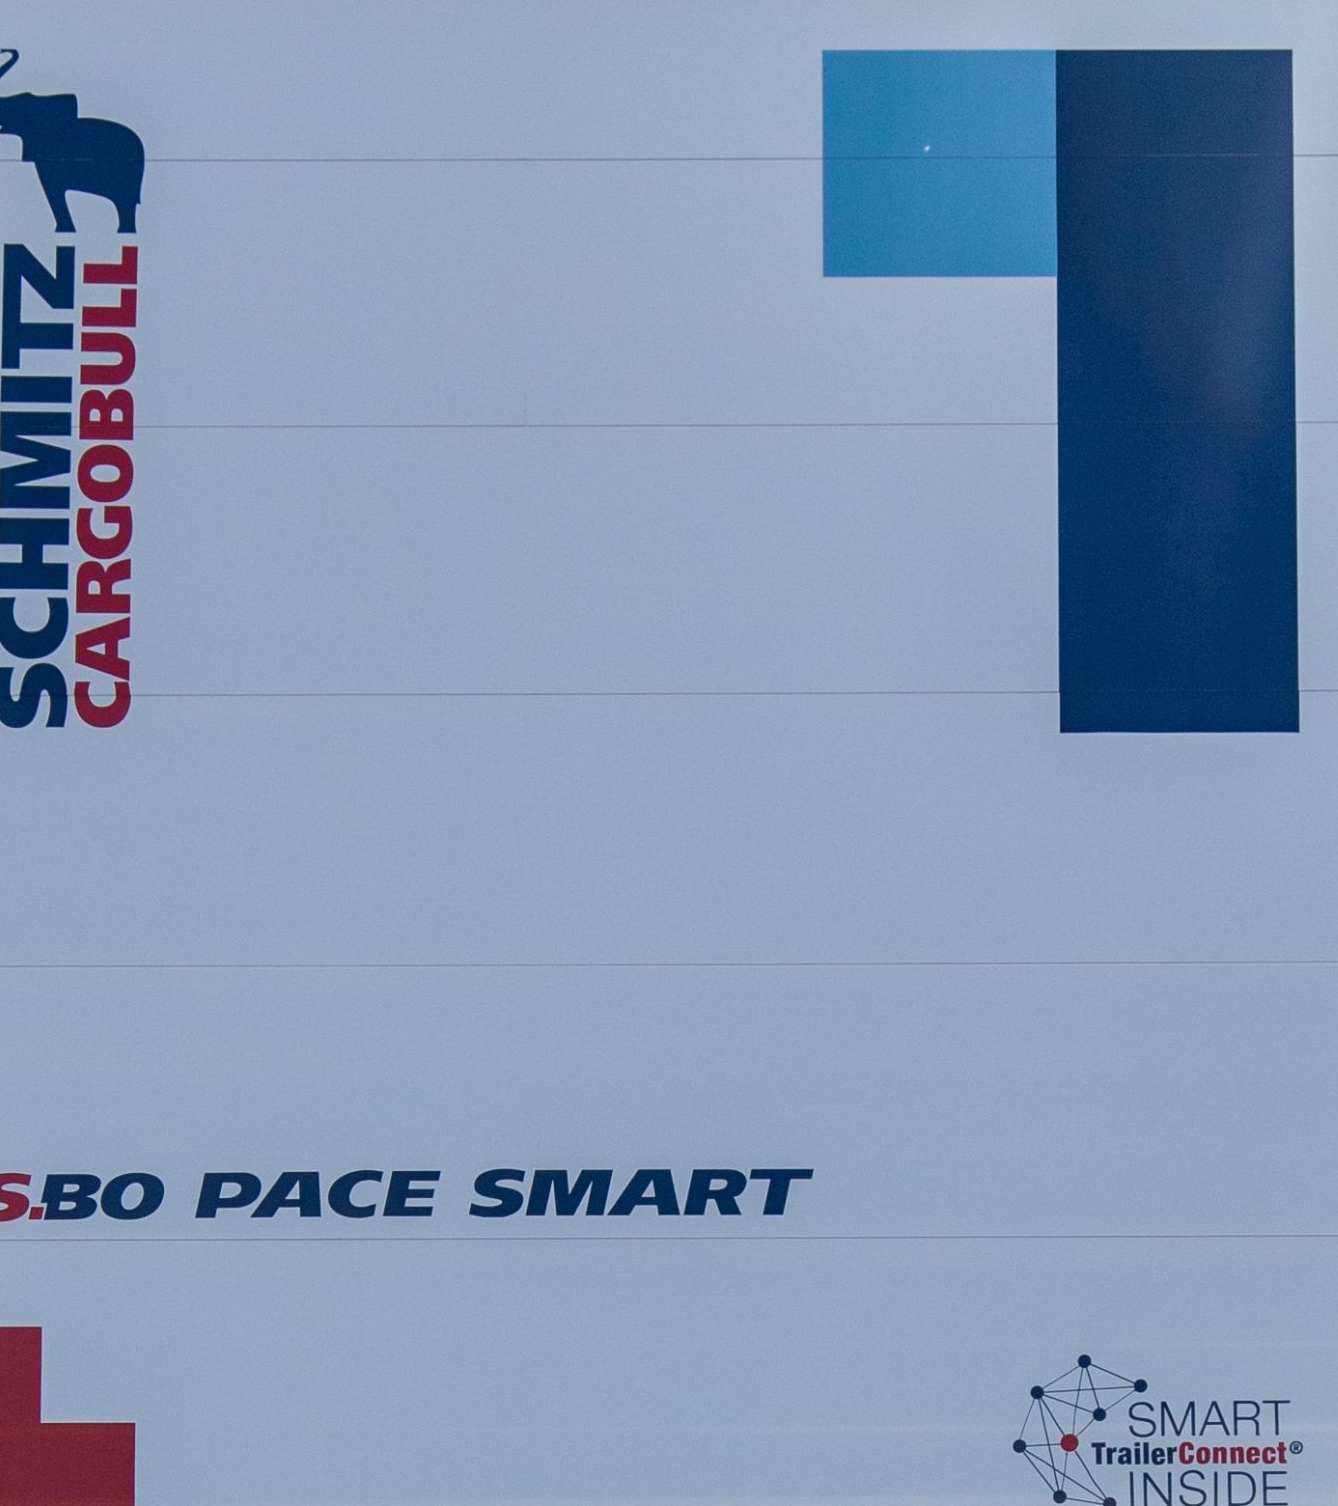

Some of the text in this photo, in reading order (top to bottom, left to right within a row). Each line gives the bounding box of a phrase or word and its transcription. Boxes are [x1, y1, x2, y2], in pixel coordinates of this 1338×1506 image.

[73, 245, 139, 728] CARGOBULL
[194, 1169, 442, 1219] PACE
[468, 1168, 814, 1218] SMART
[1128, 1400, 1291, 1438] SMART
[1129, 1469, 1288, 1506] INSIDE
